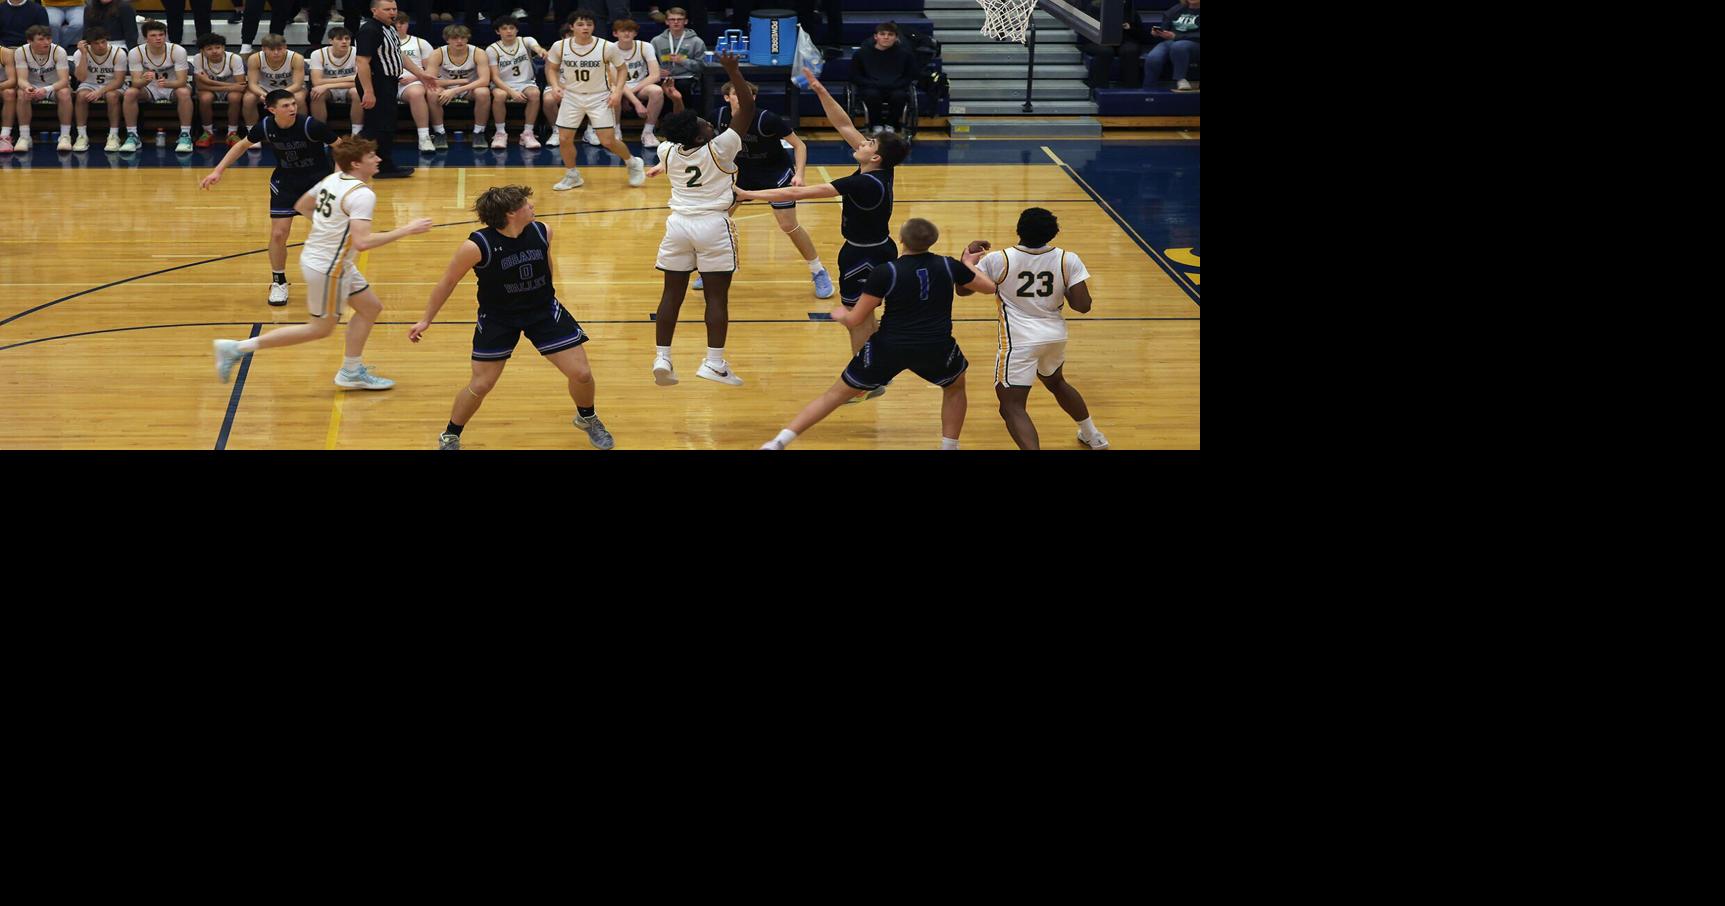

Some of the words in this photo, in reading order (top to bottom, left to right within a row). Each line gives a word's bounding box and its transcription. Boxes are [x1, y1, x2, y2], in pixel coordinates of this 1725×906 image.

[511, 65, 521, 77] 3
[580, 60, 601, 68] BRIDGE
[96, 74, 105, 84] 5
[574, 69, 590, 82] 10
[685, 165, 702, 188] 2
[315, 188, 336, 218] 35
[519, 263, 534, 280] 0
[916, 268, 930, 300] 1
[1016, 270, 1054, 298] 23
